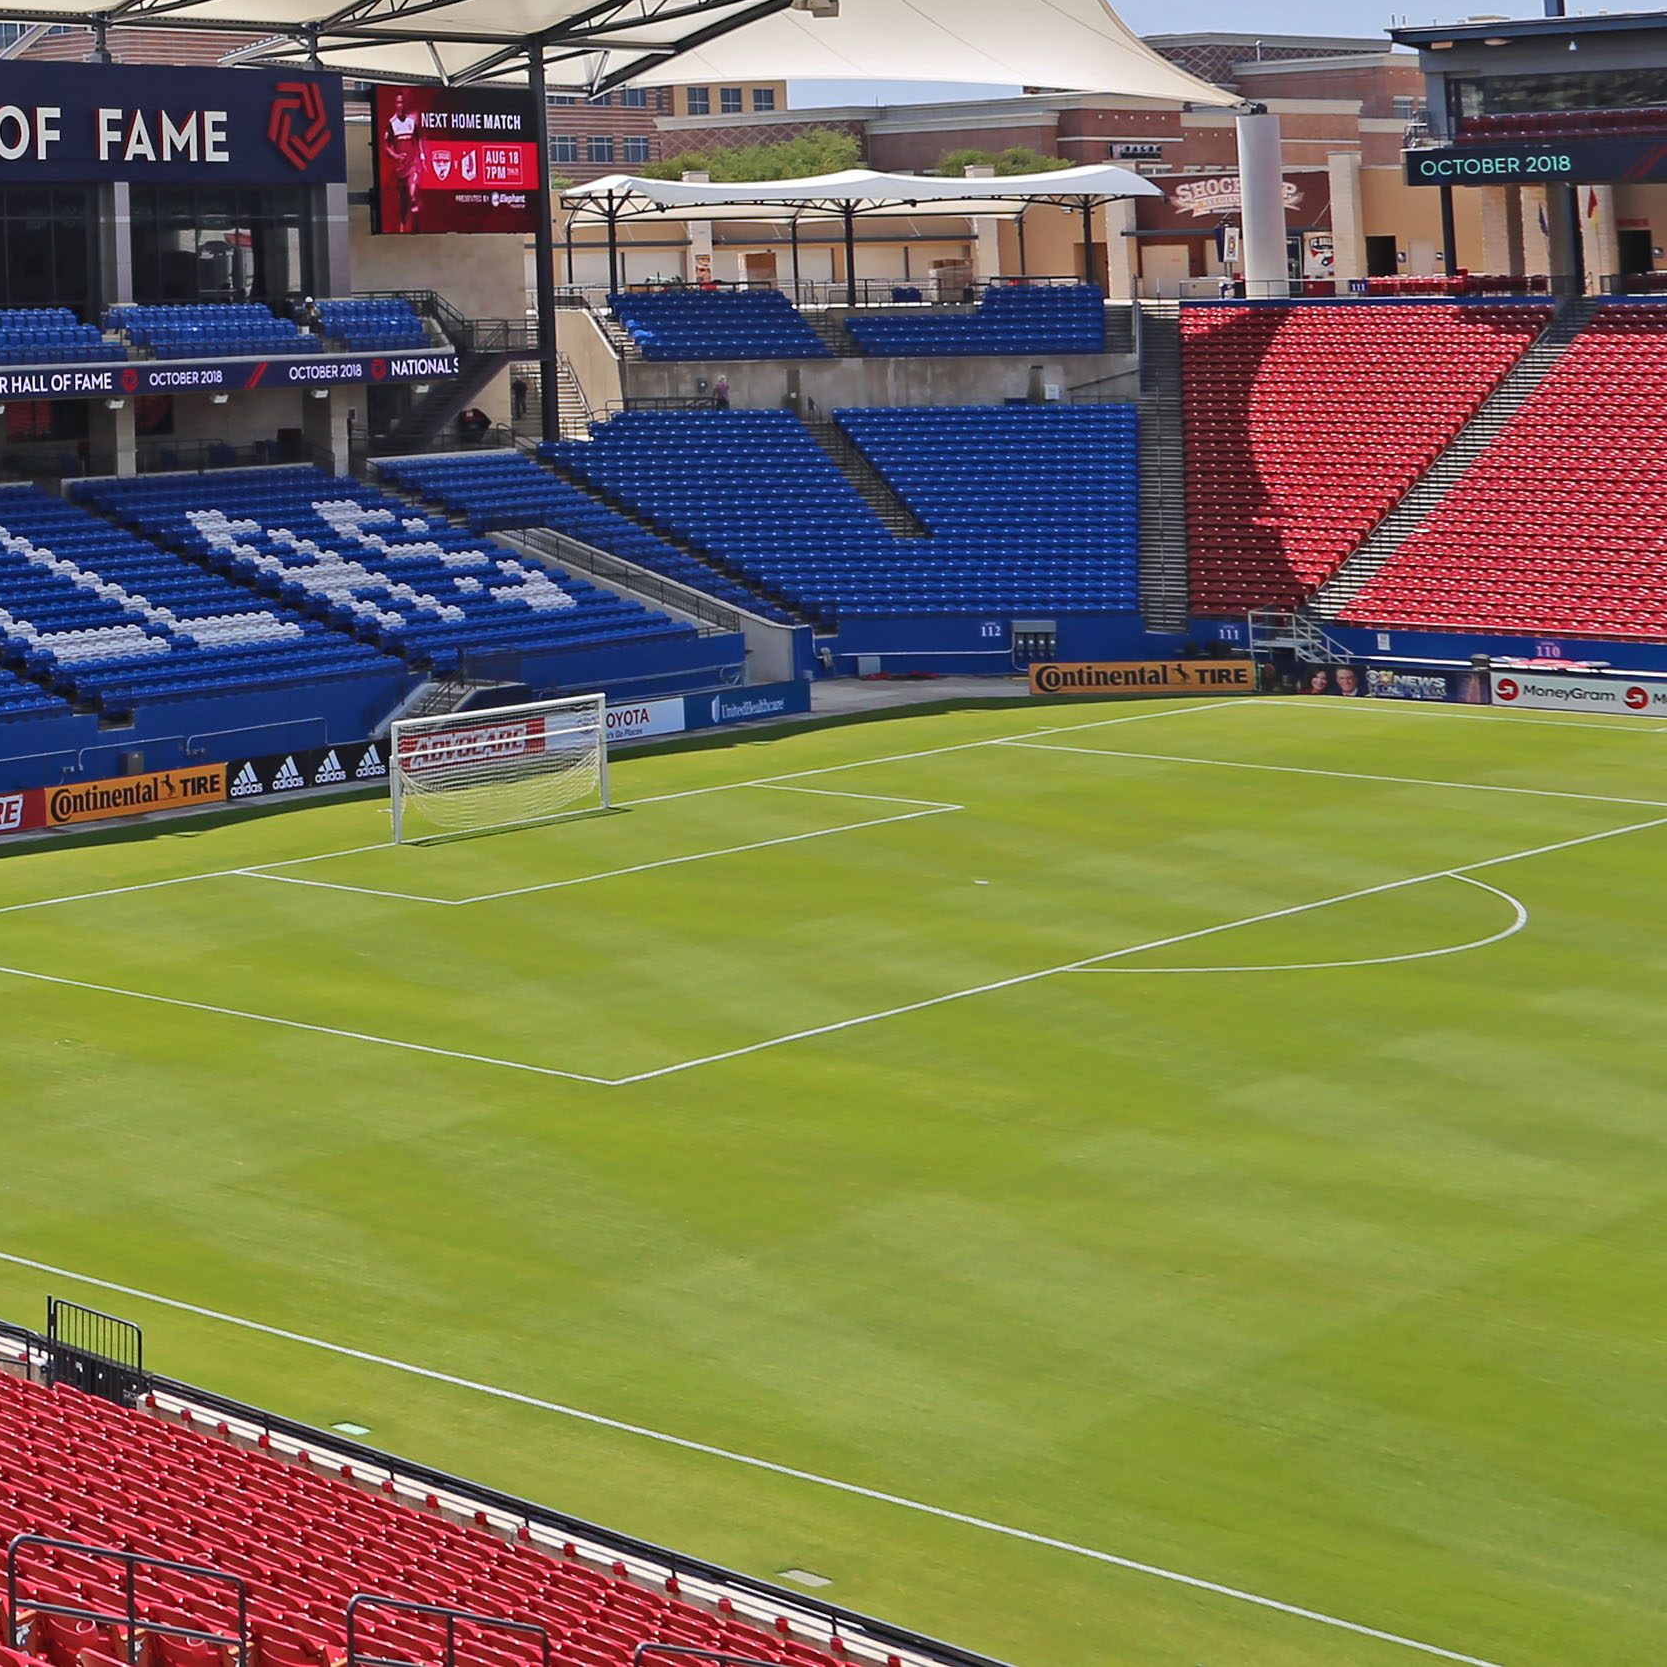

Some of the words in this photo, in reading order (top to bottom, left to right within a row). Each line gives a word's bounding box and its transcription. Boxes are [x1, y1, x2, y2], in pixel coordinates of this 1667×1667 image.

[421, 113, 448, 128] NEXT
[451, 114, 481, 129] HOME
[484, 114, 521, 130] MATCH
[96, 109, 229, 164] FAME
[485, 151, 506, 164] AUG
[508, 151, 519, 165] 18
[1420, 157, 1520, 176] OCTOBER
[1526, 155, 1571, 173] 2018
[486, 166, 506, 179] 7PM
[289, 366, 338, 380] OCTOBER
[340, 363, 362, 378] 2018
[391, 359, 451, 376] NATIONAL
[11, 375, 48, 394] HALL
[52, 374, 71, 392] OF
[75, 372, 112, 390] FAME
[149, 370, 199, 386] OCTOBER
[201, 369, 223, 384] 2018
[981, 625, 1001, 637] 112
[1219, 628, 1240, 640] 111
[1535, 645, 1561, 658] 110
[1035, 664, 1169, 692] Continental
[1195, 667, 1248, 684] TIRE
[1394, 675, 1446, 688] NEWS
[1523, 684, 1616, 702] MoneyGram
[606, 708, 650, 728] OYOTA
[315, 770, 346, 783] adidas
[356, 764, 386, 778] adidas
[230, 782, 263, 797] adidas
[272, 775, 304, 790] adidas
[51, 777, 158, 822] Continental
[180, 773, 221, 798] TIRE
